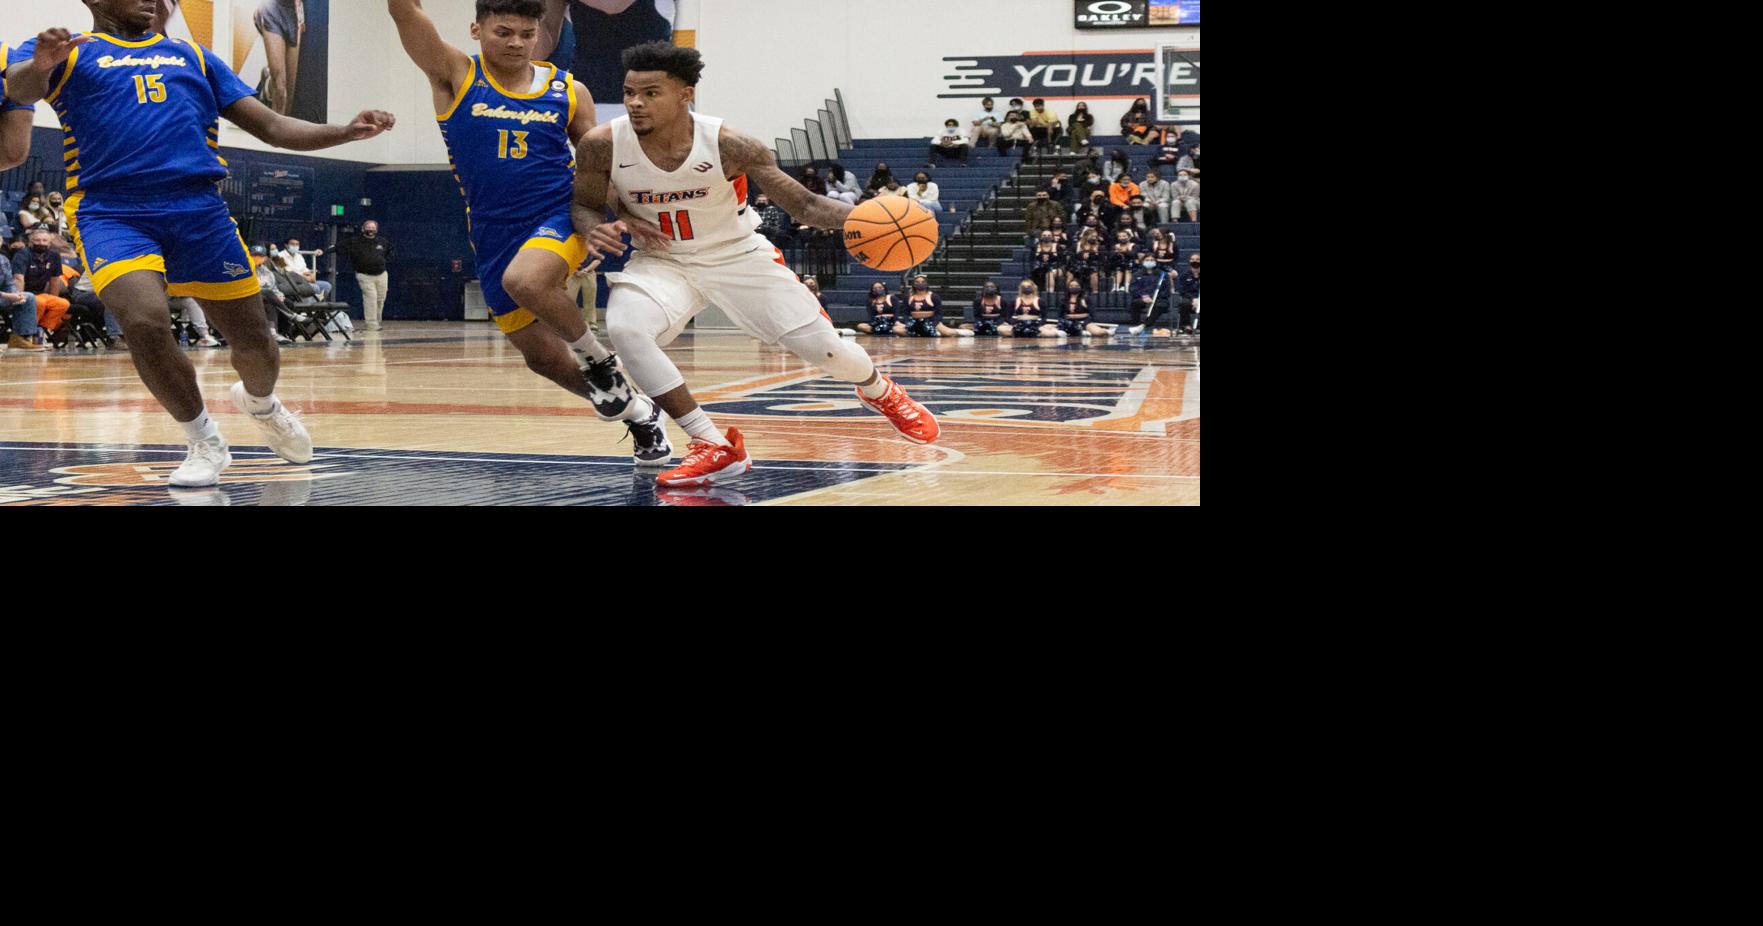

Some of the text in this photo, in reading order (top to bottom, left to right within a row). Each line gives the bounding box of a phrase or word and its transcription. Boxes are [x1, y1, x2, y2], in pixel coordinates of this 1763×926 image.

[1077, 13, 1143, 21] OAKLEY
[97, 54, 187, 69] Bakersfield
[1013, 61, 1198, 88] YOU'RE
[132, 73, 168, 104] 15
[471, 103, 560, 125] Bakersfield
[497, 128, 530, 159] 13
[628, 187, 710, 204] TITANS
[658, 209, 694, 241] 11
